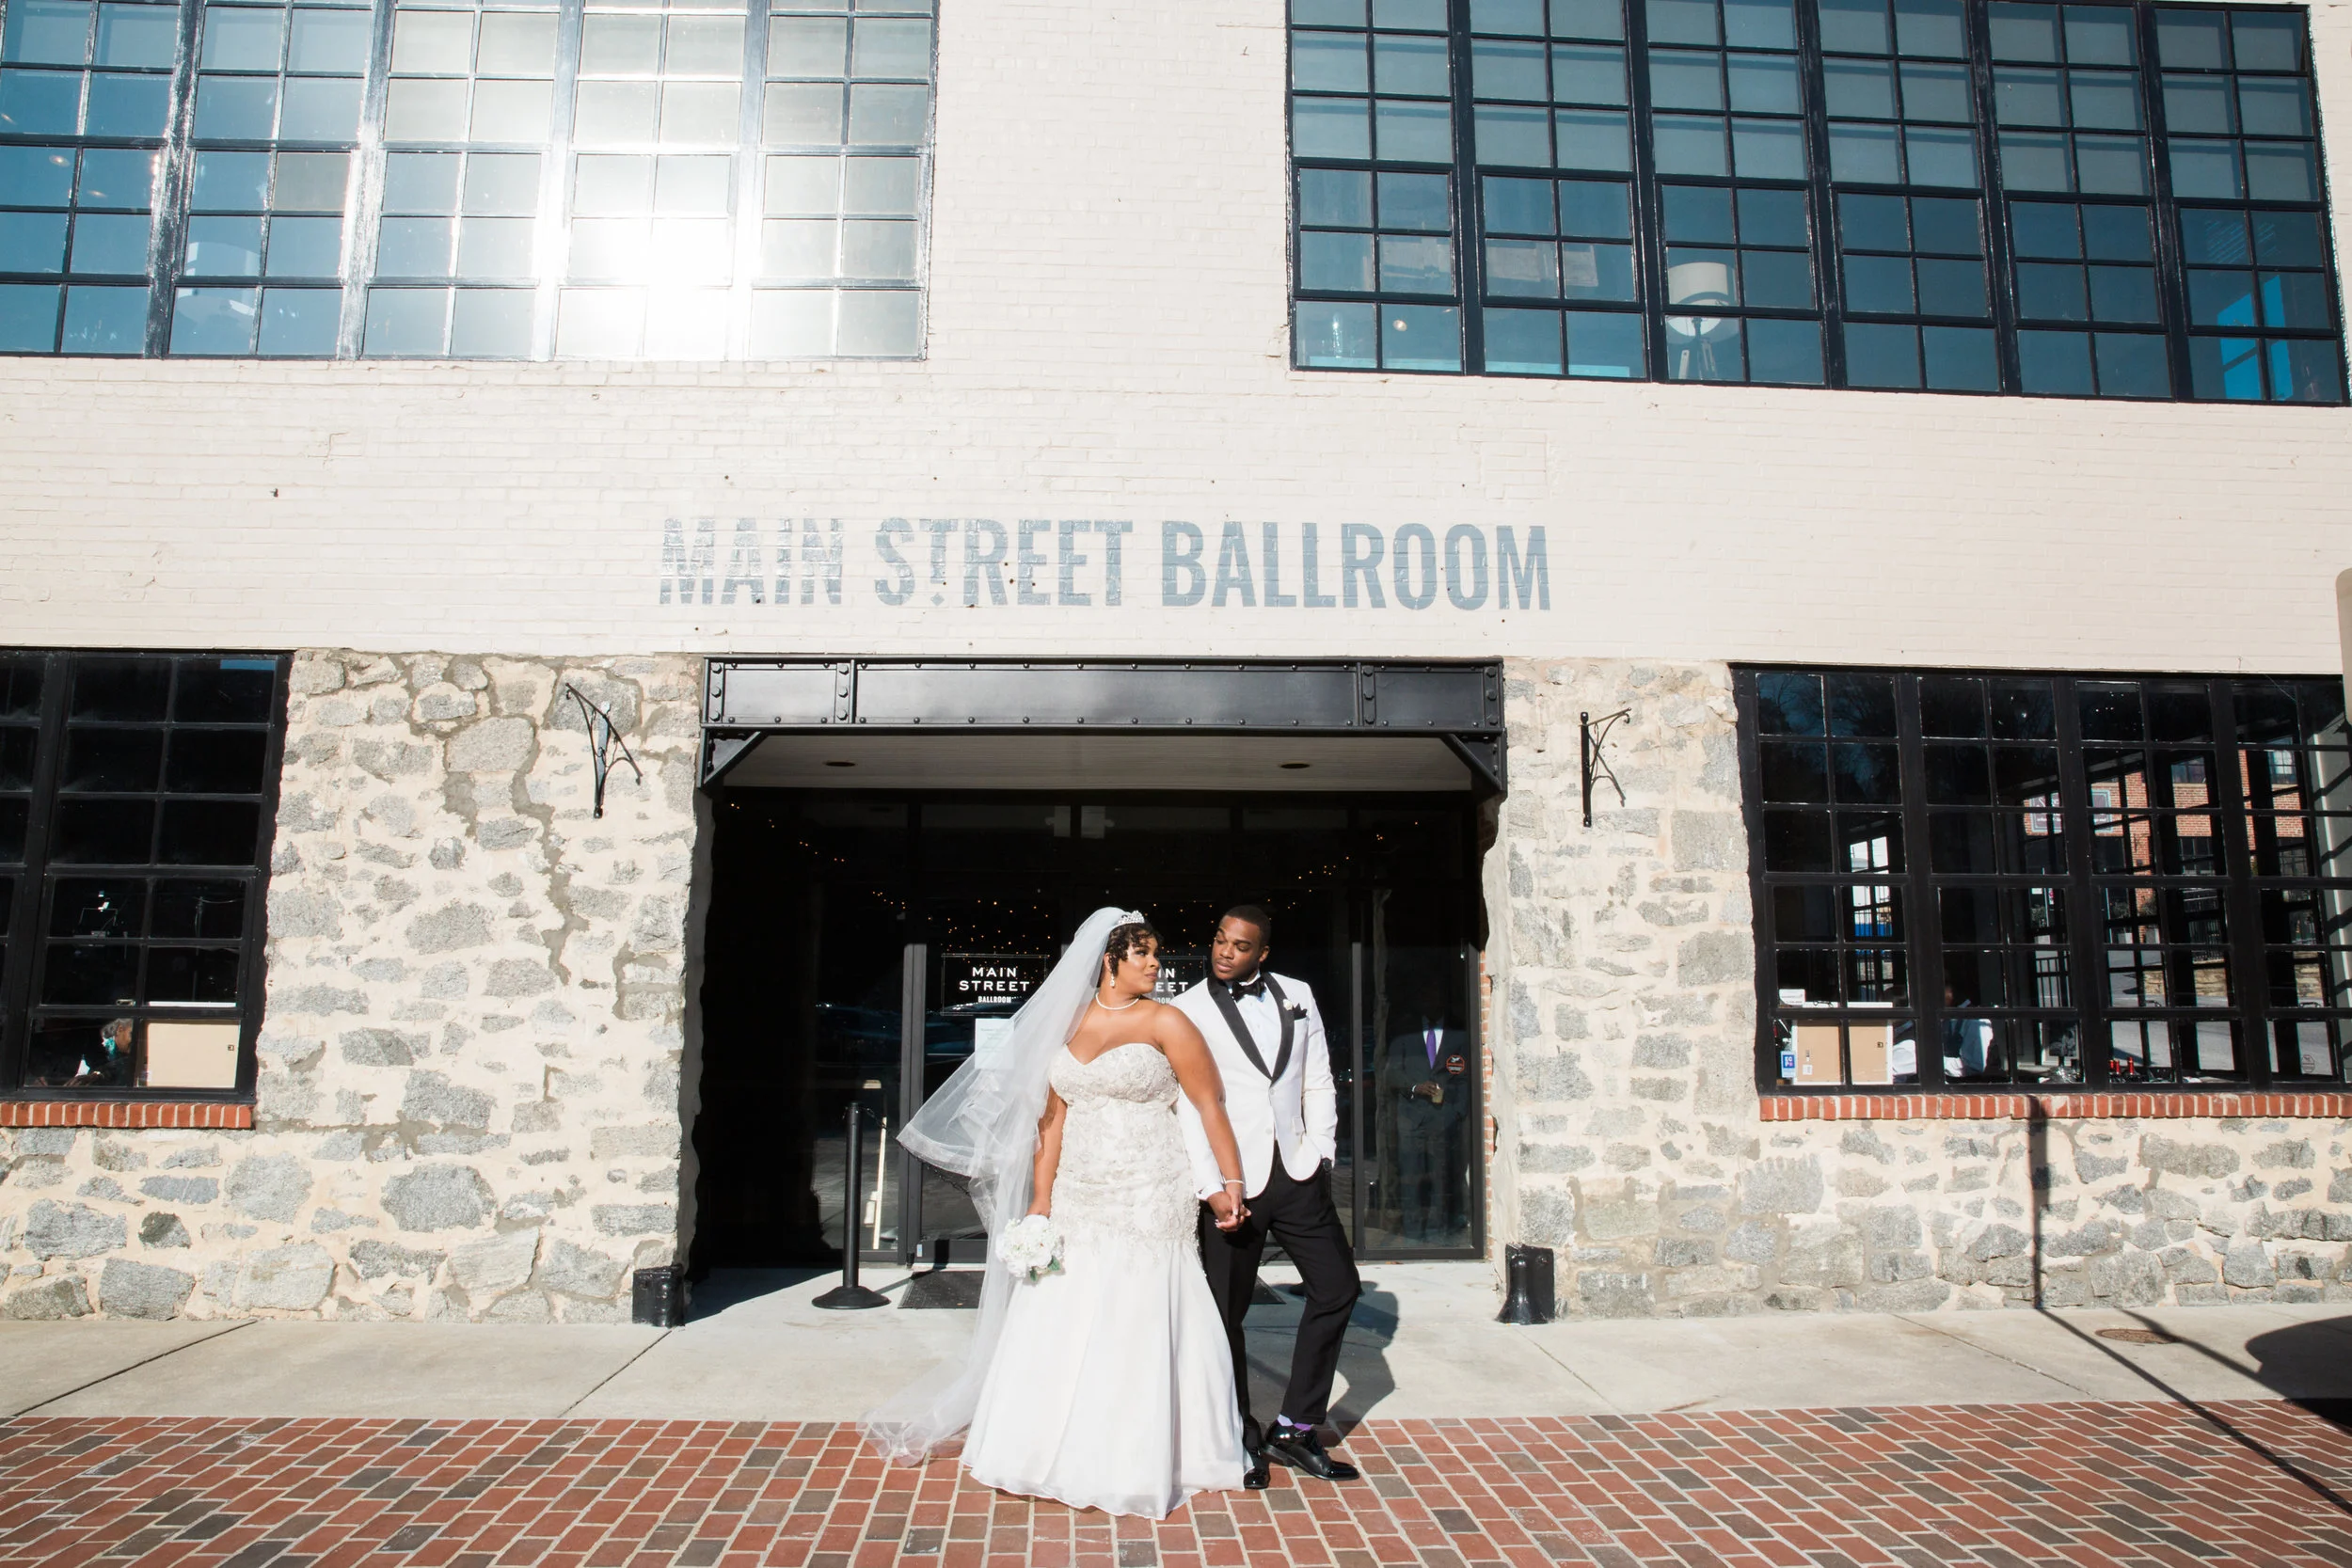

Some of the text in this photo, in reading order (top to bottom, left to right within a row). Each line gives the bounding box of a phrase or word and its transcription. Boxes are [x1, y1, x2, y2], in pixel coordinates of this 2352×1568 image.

[660, 516, 1551, 611] MAIN STREET BALLROOM
[972, 966, 1016, 977] MAIN
[1158, 968, 1175, 978] IN
[959, 980, 1030, 991] STREET
[1155, 981, 1189, 992] EET
[977, 995, 1012, 1004] BALLROOM
